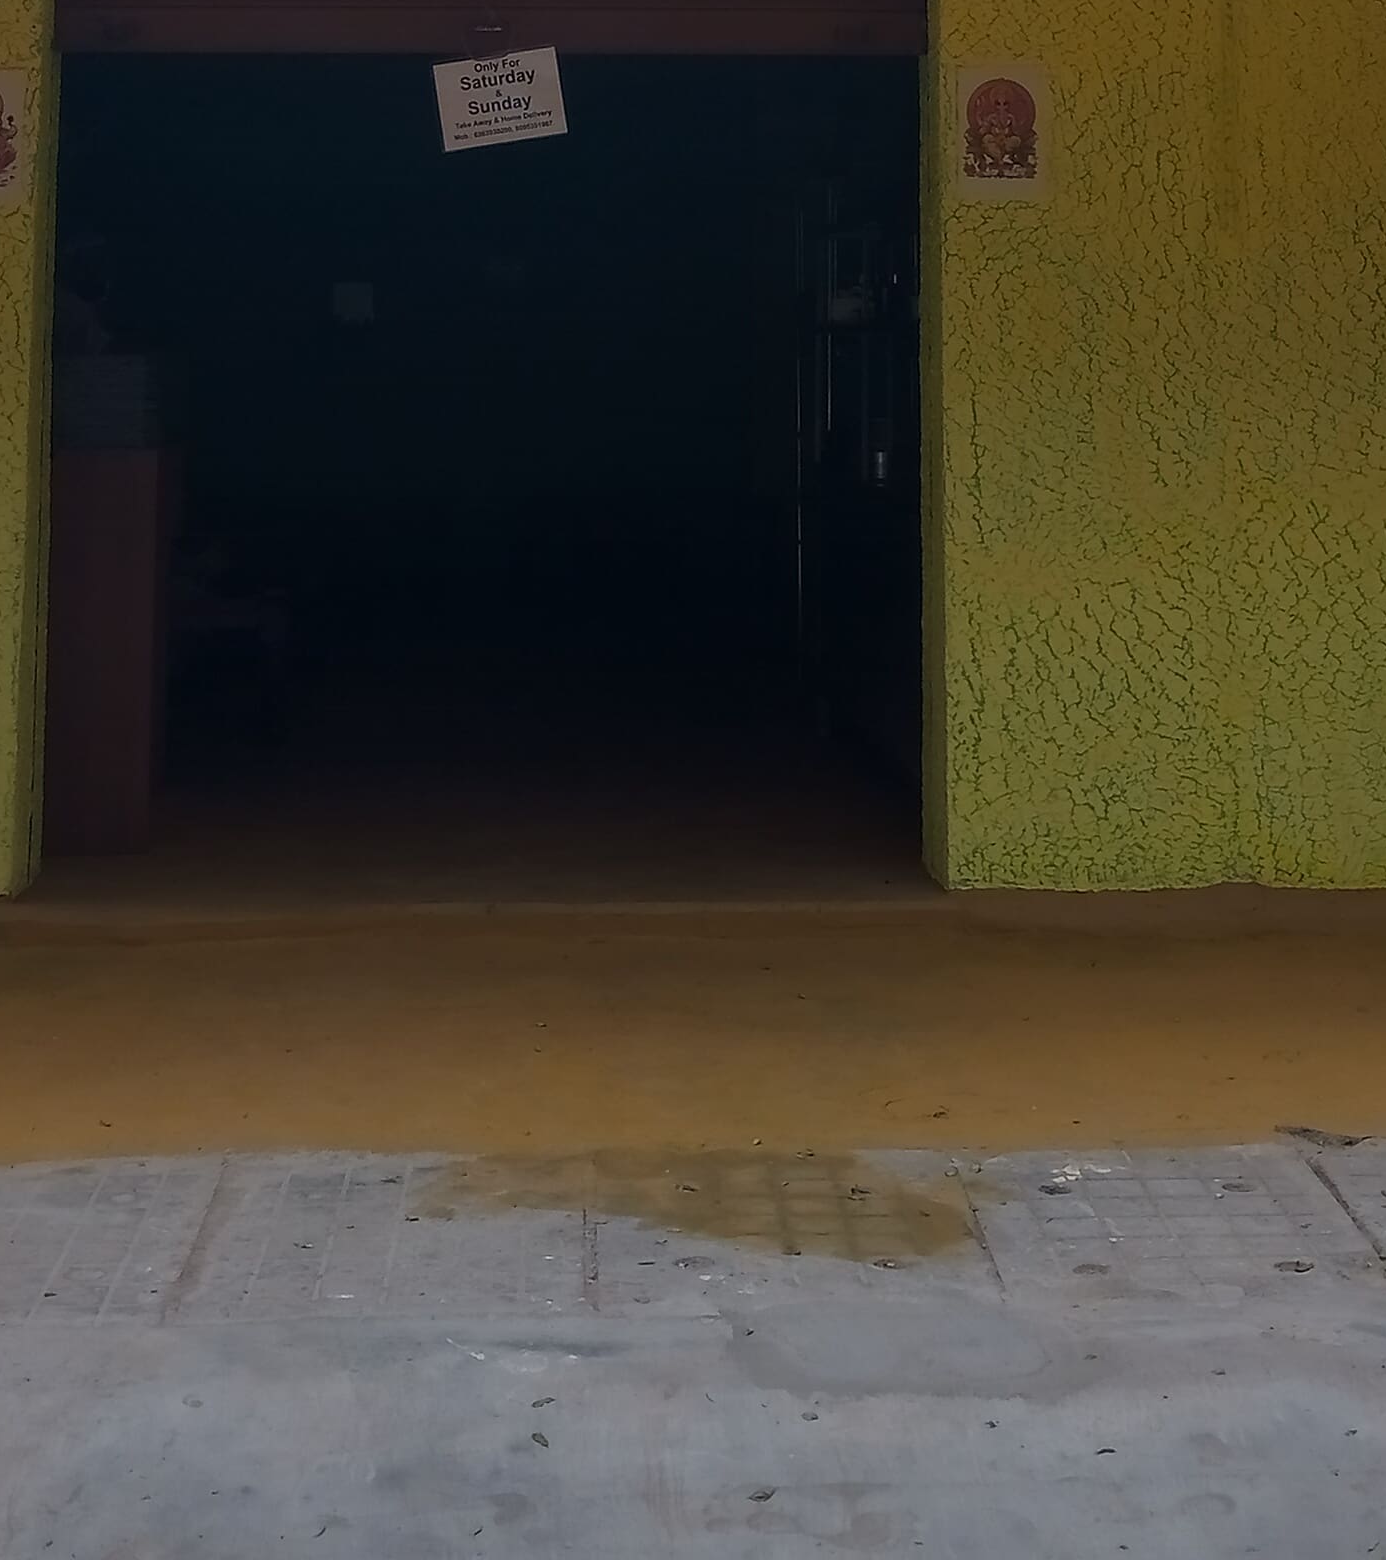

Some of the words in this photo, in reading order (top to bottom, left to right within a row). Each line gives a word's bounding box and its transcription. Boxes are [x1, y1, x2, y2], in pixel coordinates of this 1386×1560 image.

[474, 63, 499, 74] Only
[502, 58, 520, 69] For
[460, 69, 535, 91] Saturday
[495, 90, 502, 98] &
[468, 95, 532, 115] Sunday
[473, 119, 492, 128] Away
[523, 110, 552, 120] Delivery
